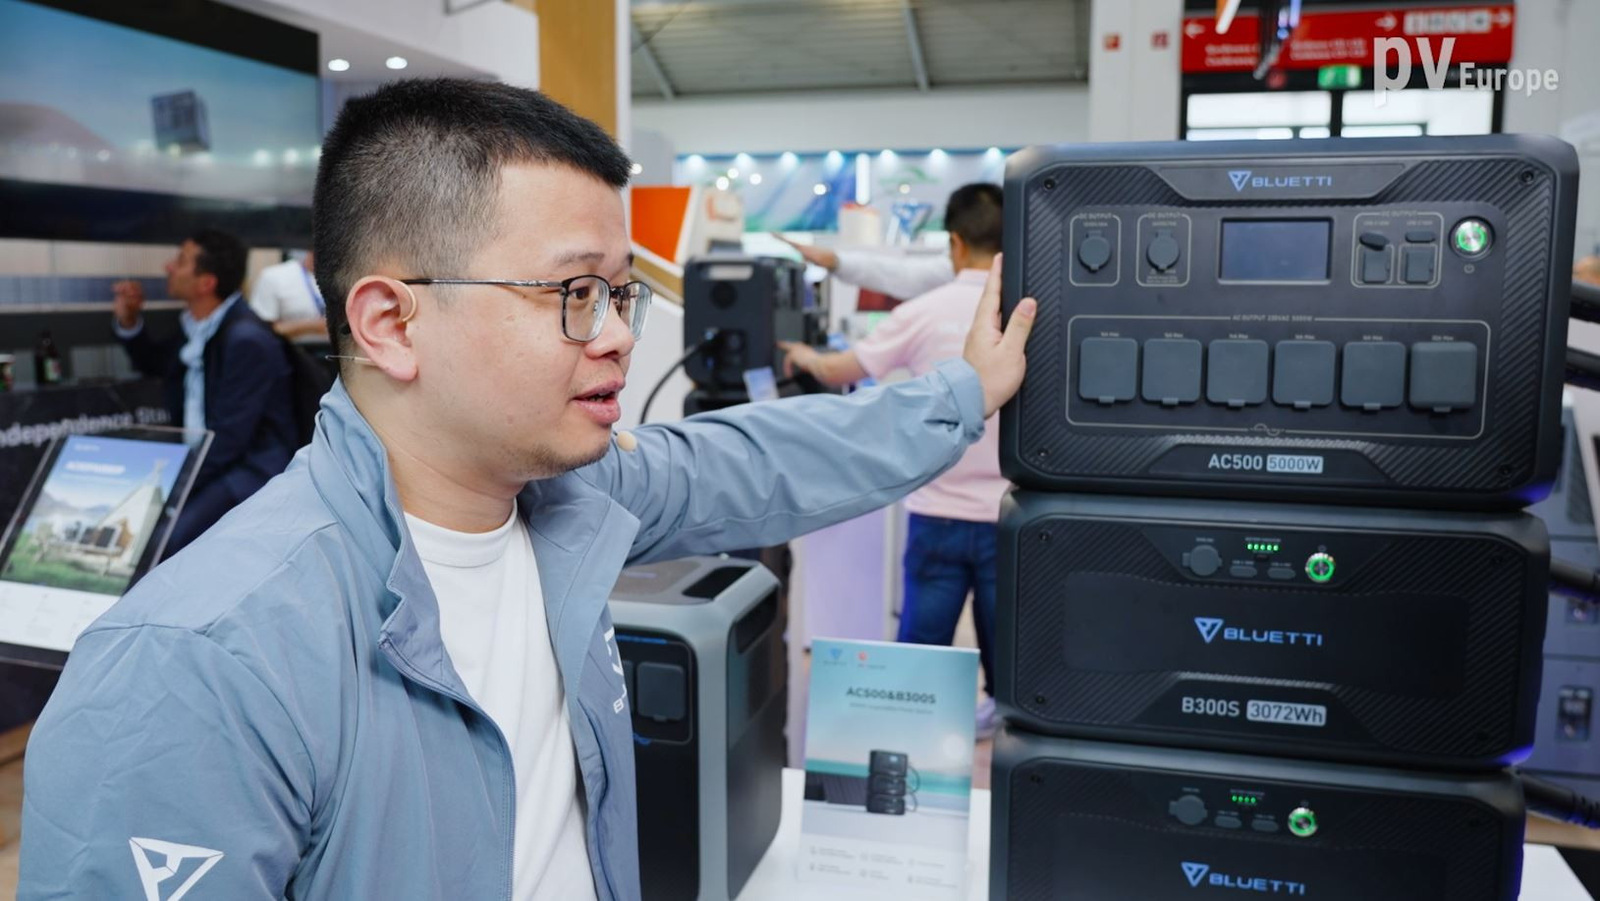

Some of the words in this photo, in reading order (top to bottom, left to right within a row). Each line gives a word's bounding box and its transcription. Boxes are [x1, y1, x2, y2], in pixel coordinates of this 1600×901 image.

[1251, 176, 1332, 188] BLUETTI
[1208, 454, 1263, 470] AC500
[1267, 457, 1321, 471] 5000W
[1223, 627, 1323, 646] BLUETTI
[846, 686, 937, 704] AC500&B300S
[1182, 697, 1240, 717] B300S
[1249, 702, 1323, 723] 3072Wh
[1208, 872, 1306, 895] BLUETTI
